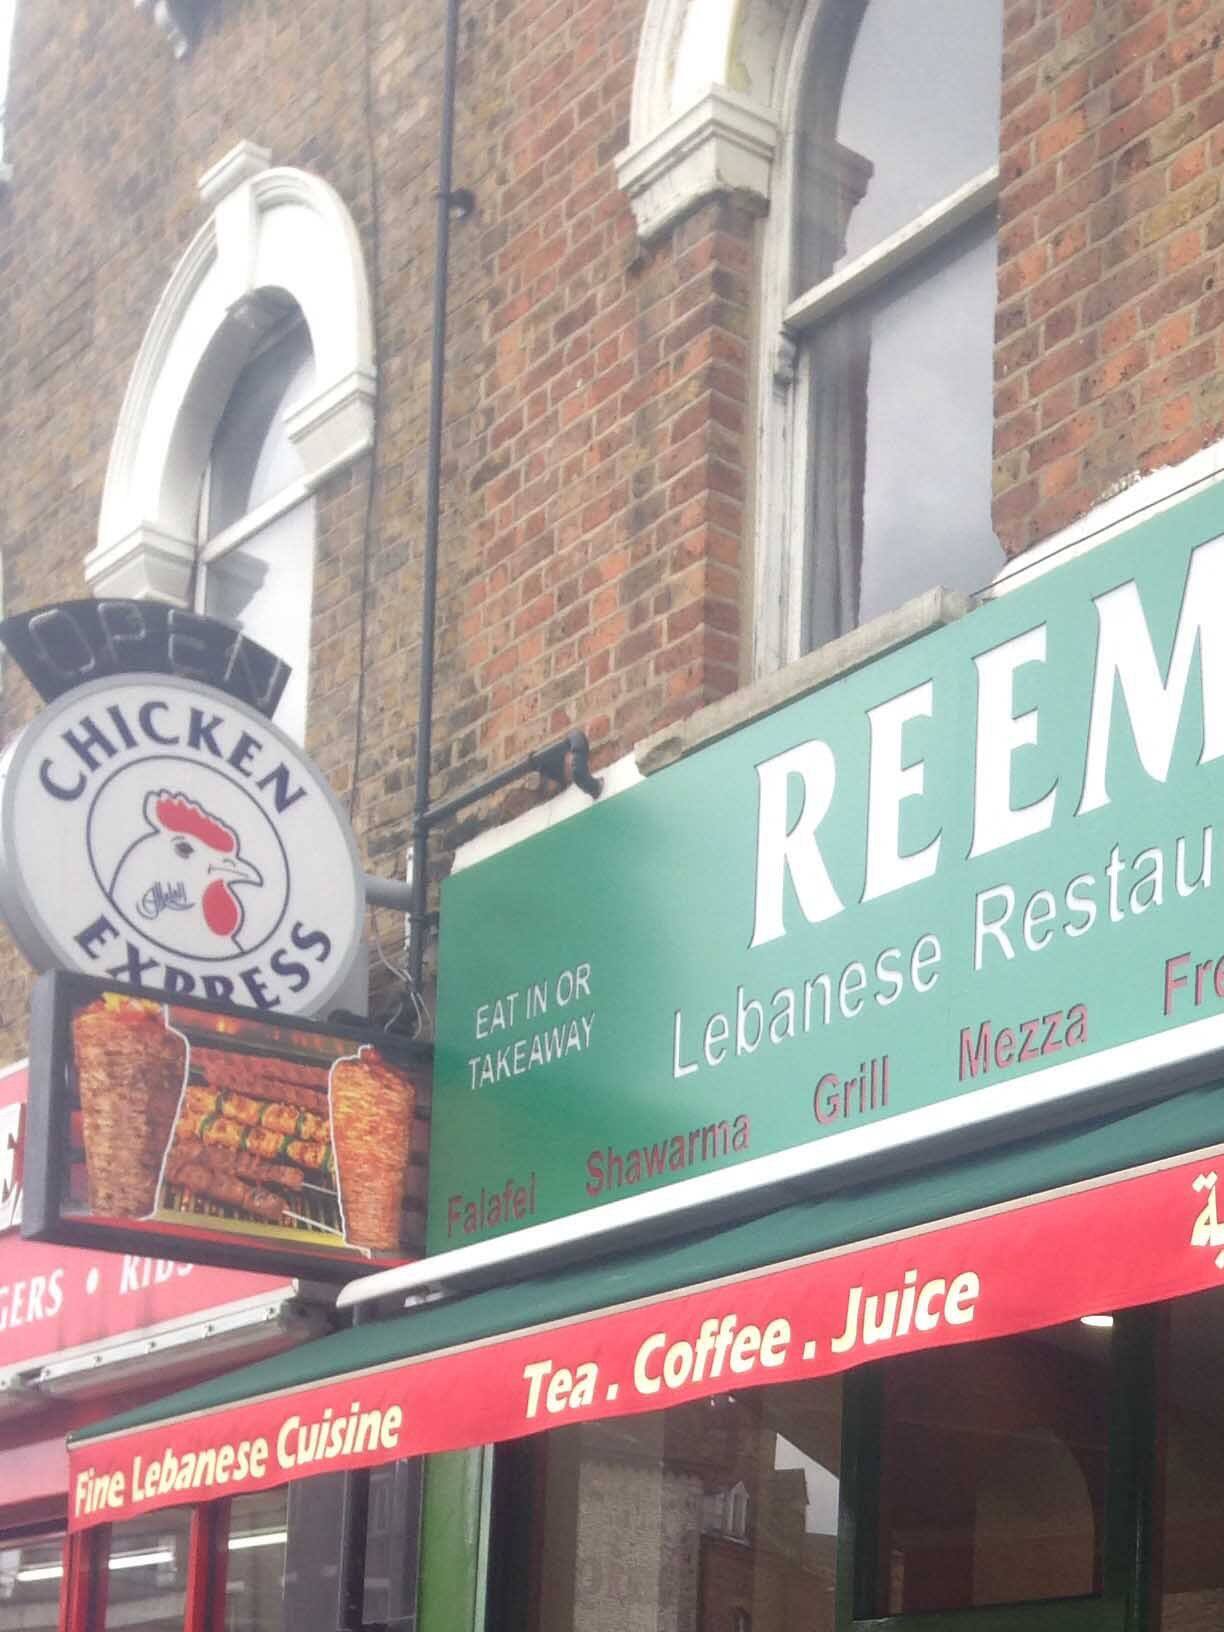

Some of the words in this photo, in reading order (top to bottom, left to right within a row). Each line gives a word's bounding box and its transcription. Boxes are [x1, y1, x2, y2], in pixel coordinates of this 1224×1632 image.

[28, 600, 281, 706] OPEN
[39, 700, 308, 815] CHICKEN
[467, 1011, 596, 1090] TAKEAWAY
[474, 992, 519, 1040] EAT
[525, 980, 548, 1020] IN
[555, 962, 591, 1008] OR
[672, 931, 942, 1080] Lebanese
[447, 1170, 536, 1239] Falafel
[586, 1112, 750, 1200] Shawarma
[812, 1055, 890, 1129] Grill
[956, 1001, 1089, 1083] Mezza
[830, 1268, 981, 1355] Juice
[75, 1455, 124, 1518] Fine
[131, 1440, 267, 1505] Lebanese
[277, 1403, 403, 1472] Cuisine
